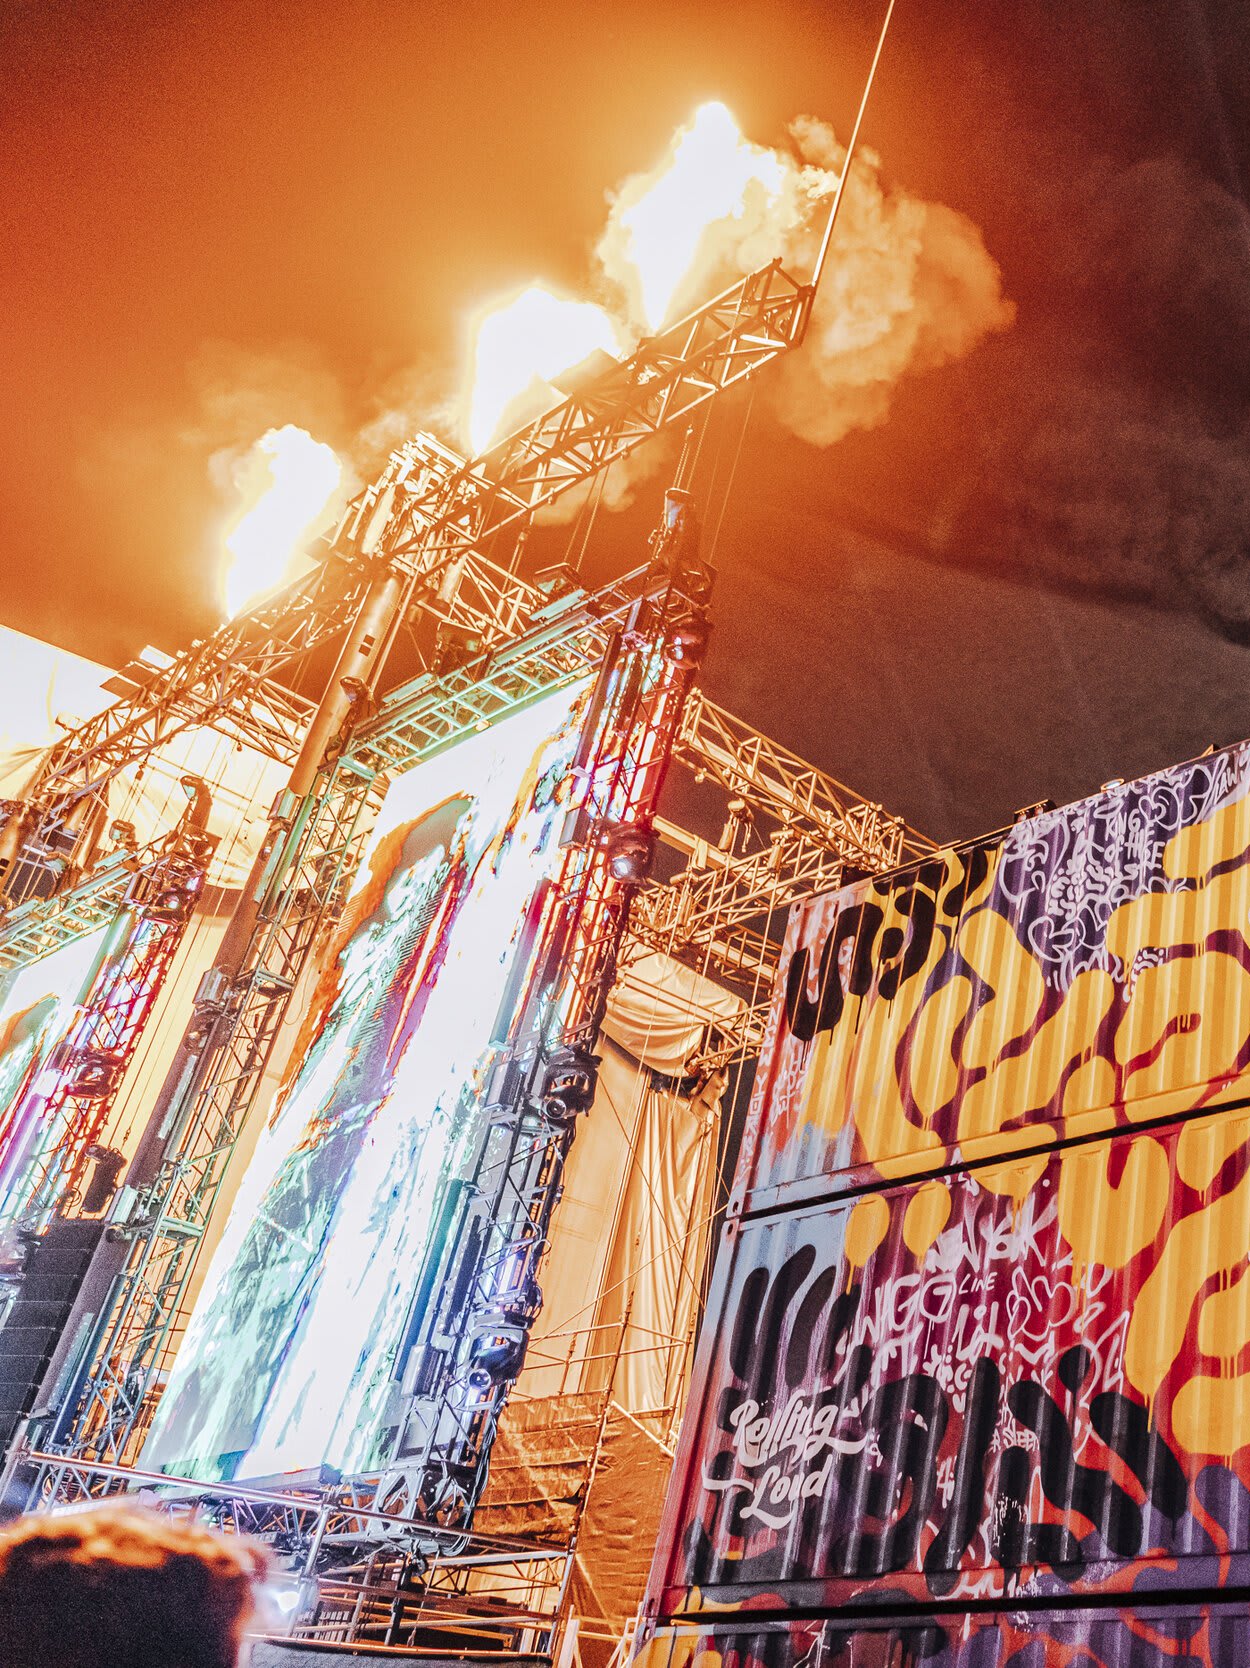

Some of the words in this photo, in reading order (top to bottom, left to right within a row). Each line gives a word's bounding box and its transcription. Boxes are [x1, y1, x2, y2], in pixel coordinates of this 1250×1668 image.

[958, 1272, 998, 1295] LINE
[730, 1390, 868, 1467] Rolling
[702, 1454, 832, 1529] Loud
